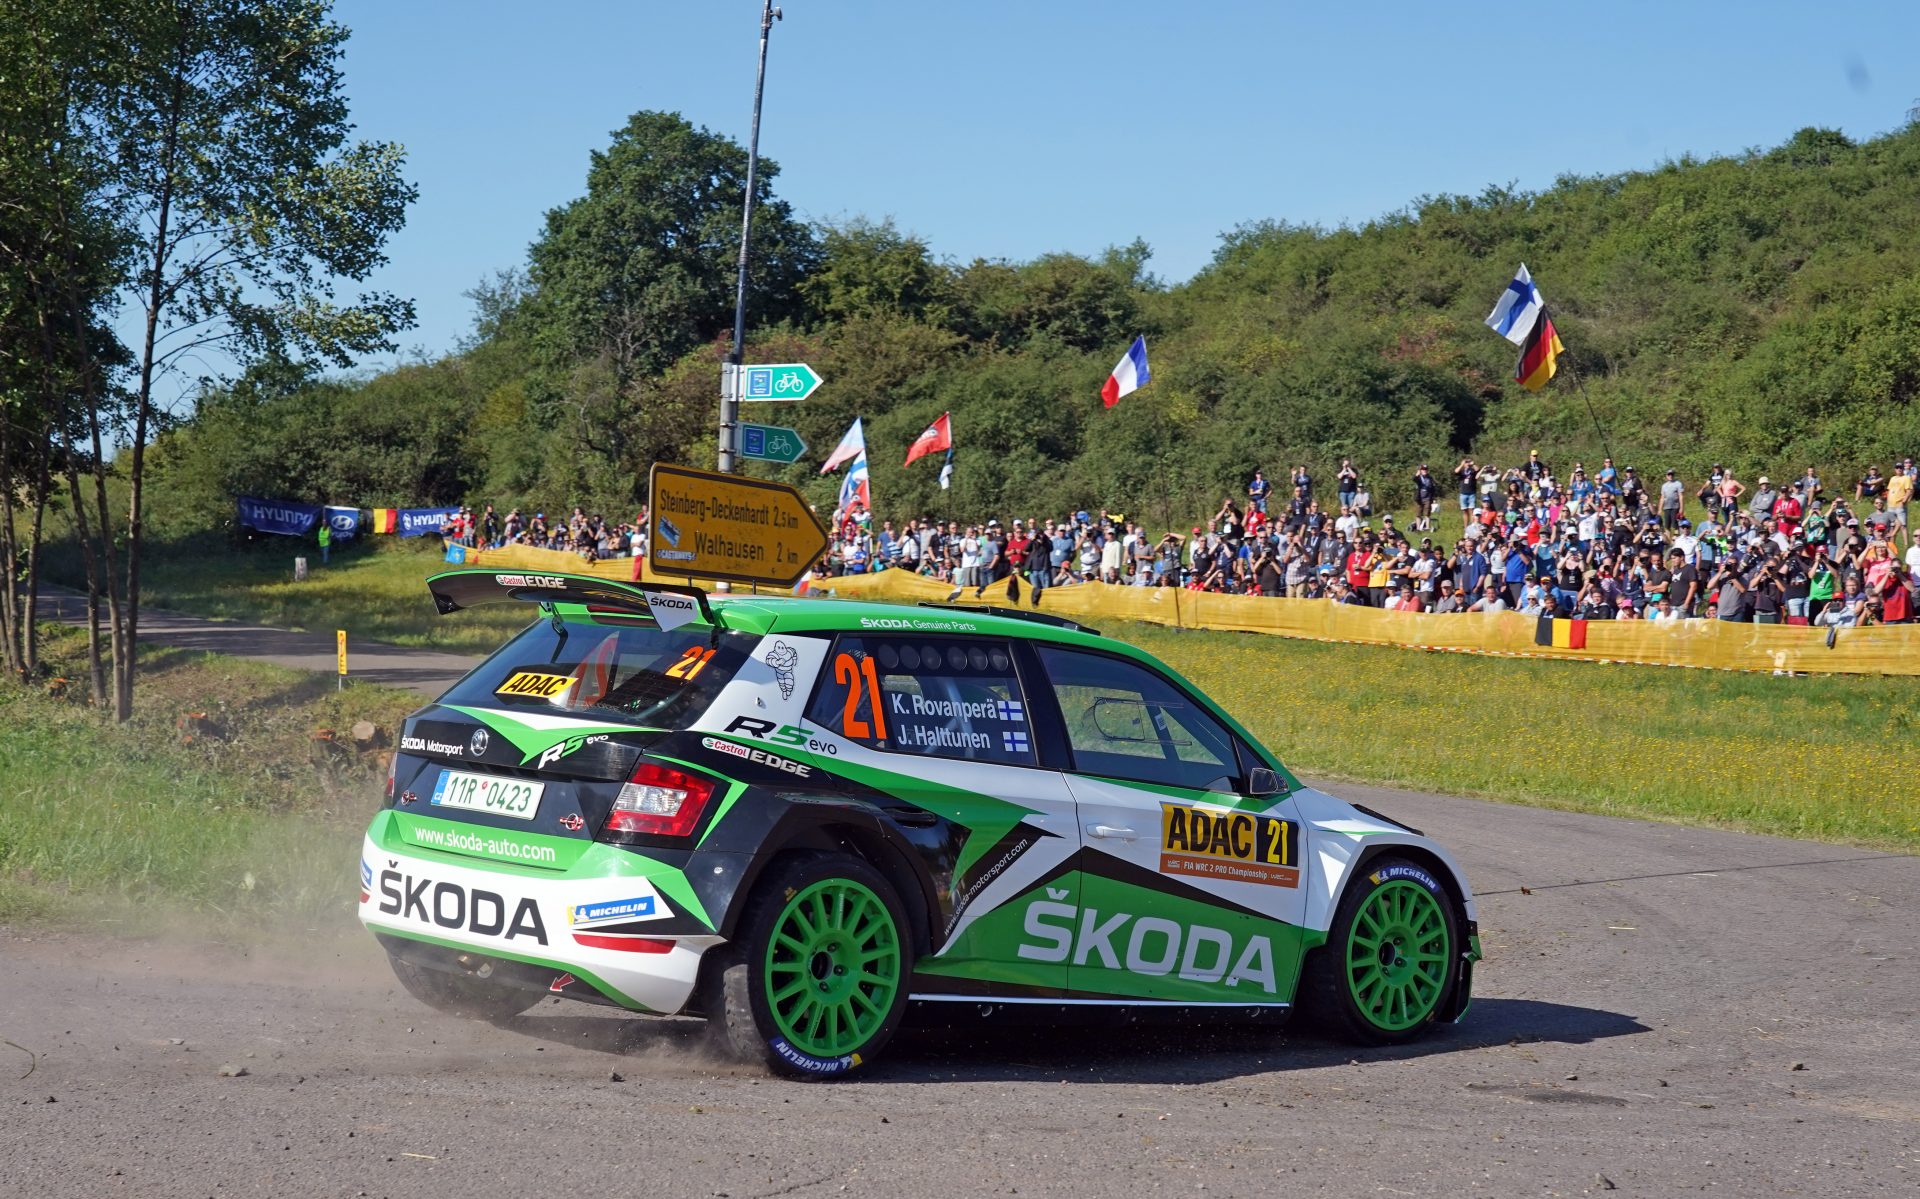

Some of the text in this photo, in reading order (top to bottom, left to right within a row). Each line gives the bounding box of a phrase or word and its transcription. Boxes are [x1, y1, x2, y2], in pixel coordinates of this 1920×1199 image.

[660, 489, 769, 525] Steinberg-Deckenhardt
[788, 514, 798, 528] km
[694, 531, 764, 559] Walhausen
[777, 542, 783, 562] 2
[787, 549, 798, 564] km
[503, 576, 567, 589] Castrol EDGE
[650, 597, 693, 610] ŠKODA
[860, 617, 976, 631] ŠKODA Genuine Parts
[665, 646, 717, 681] 21
[504, 674, 567, 696] ADAC
[835, 653, 887, 740] 21
[892, 694, 997, 722] K. Rovanperä
[401, 735, 463, 756] ŠKODA Motorsport
[538, 734, 609, 769] R5 evo
[723, 715, 837, 755] R5 evo
[898, 725, 991, 749] J. Halttunen
[714, 740, 812, 778] Castrol EDGE
[451, 776, 532, 813] 11R 0423
[415, 826, 556, 862] www.skoda-auto.com
[1167, 807, 1252, 858] ADAC
[1267, 819, 1288, 865] 21
[944, 838, 1028, 936] www.skoda-motorsport.com
[1184, 861, 1194, 870] FIA
[1195, 862, 1209, 872] WRC
[1209, 864, 1214, 872] 2
[1215, 865, 1227, 874] PRO
[1228, 866, 1268, 880] Championship
[1389, 867, 1436, 889] MICHELIN
[379, 860, 549, 946] ŠKODA
[589, 902, 648, 918] MICHELIN
[1018, 888, 1277, 993] ŠKODA
[776, 1041, 839, 1072] MICHELIN
